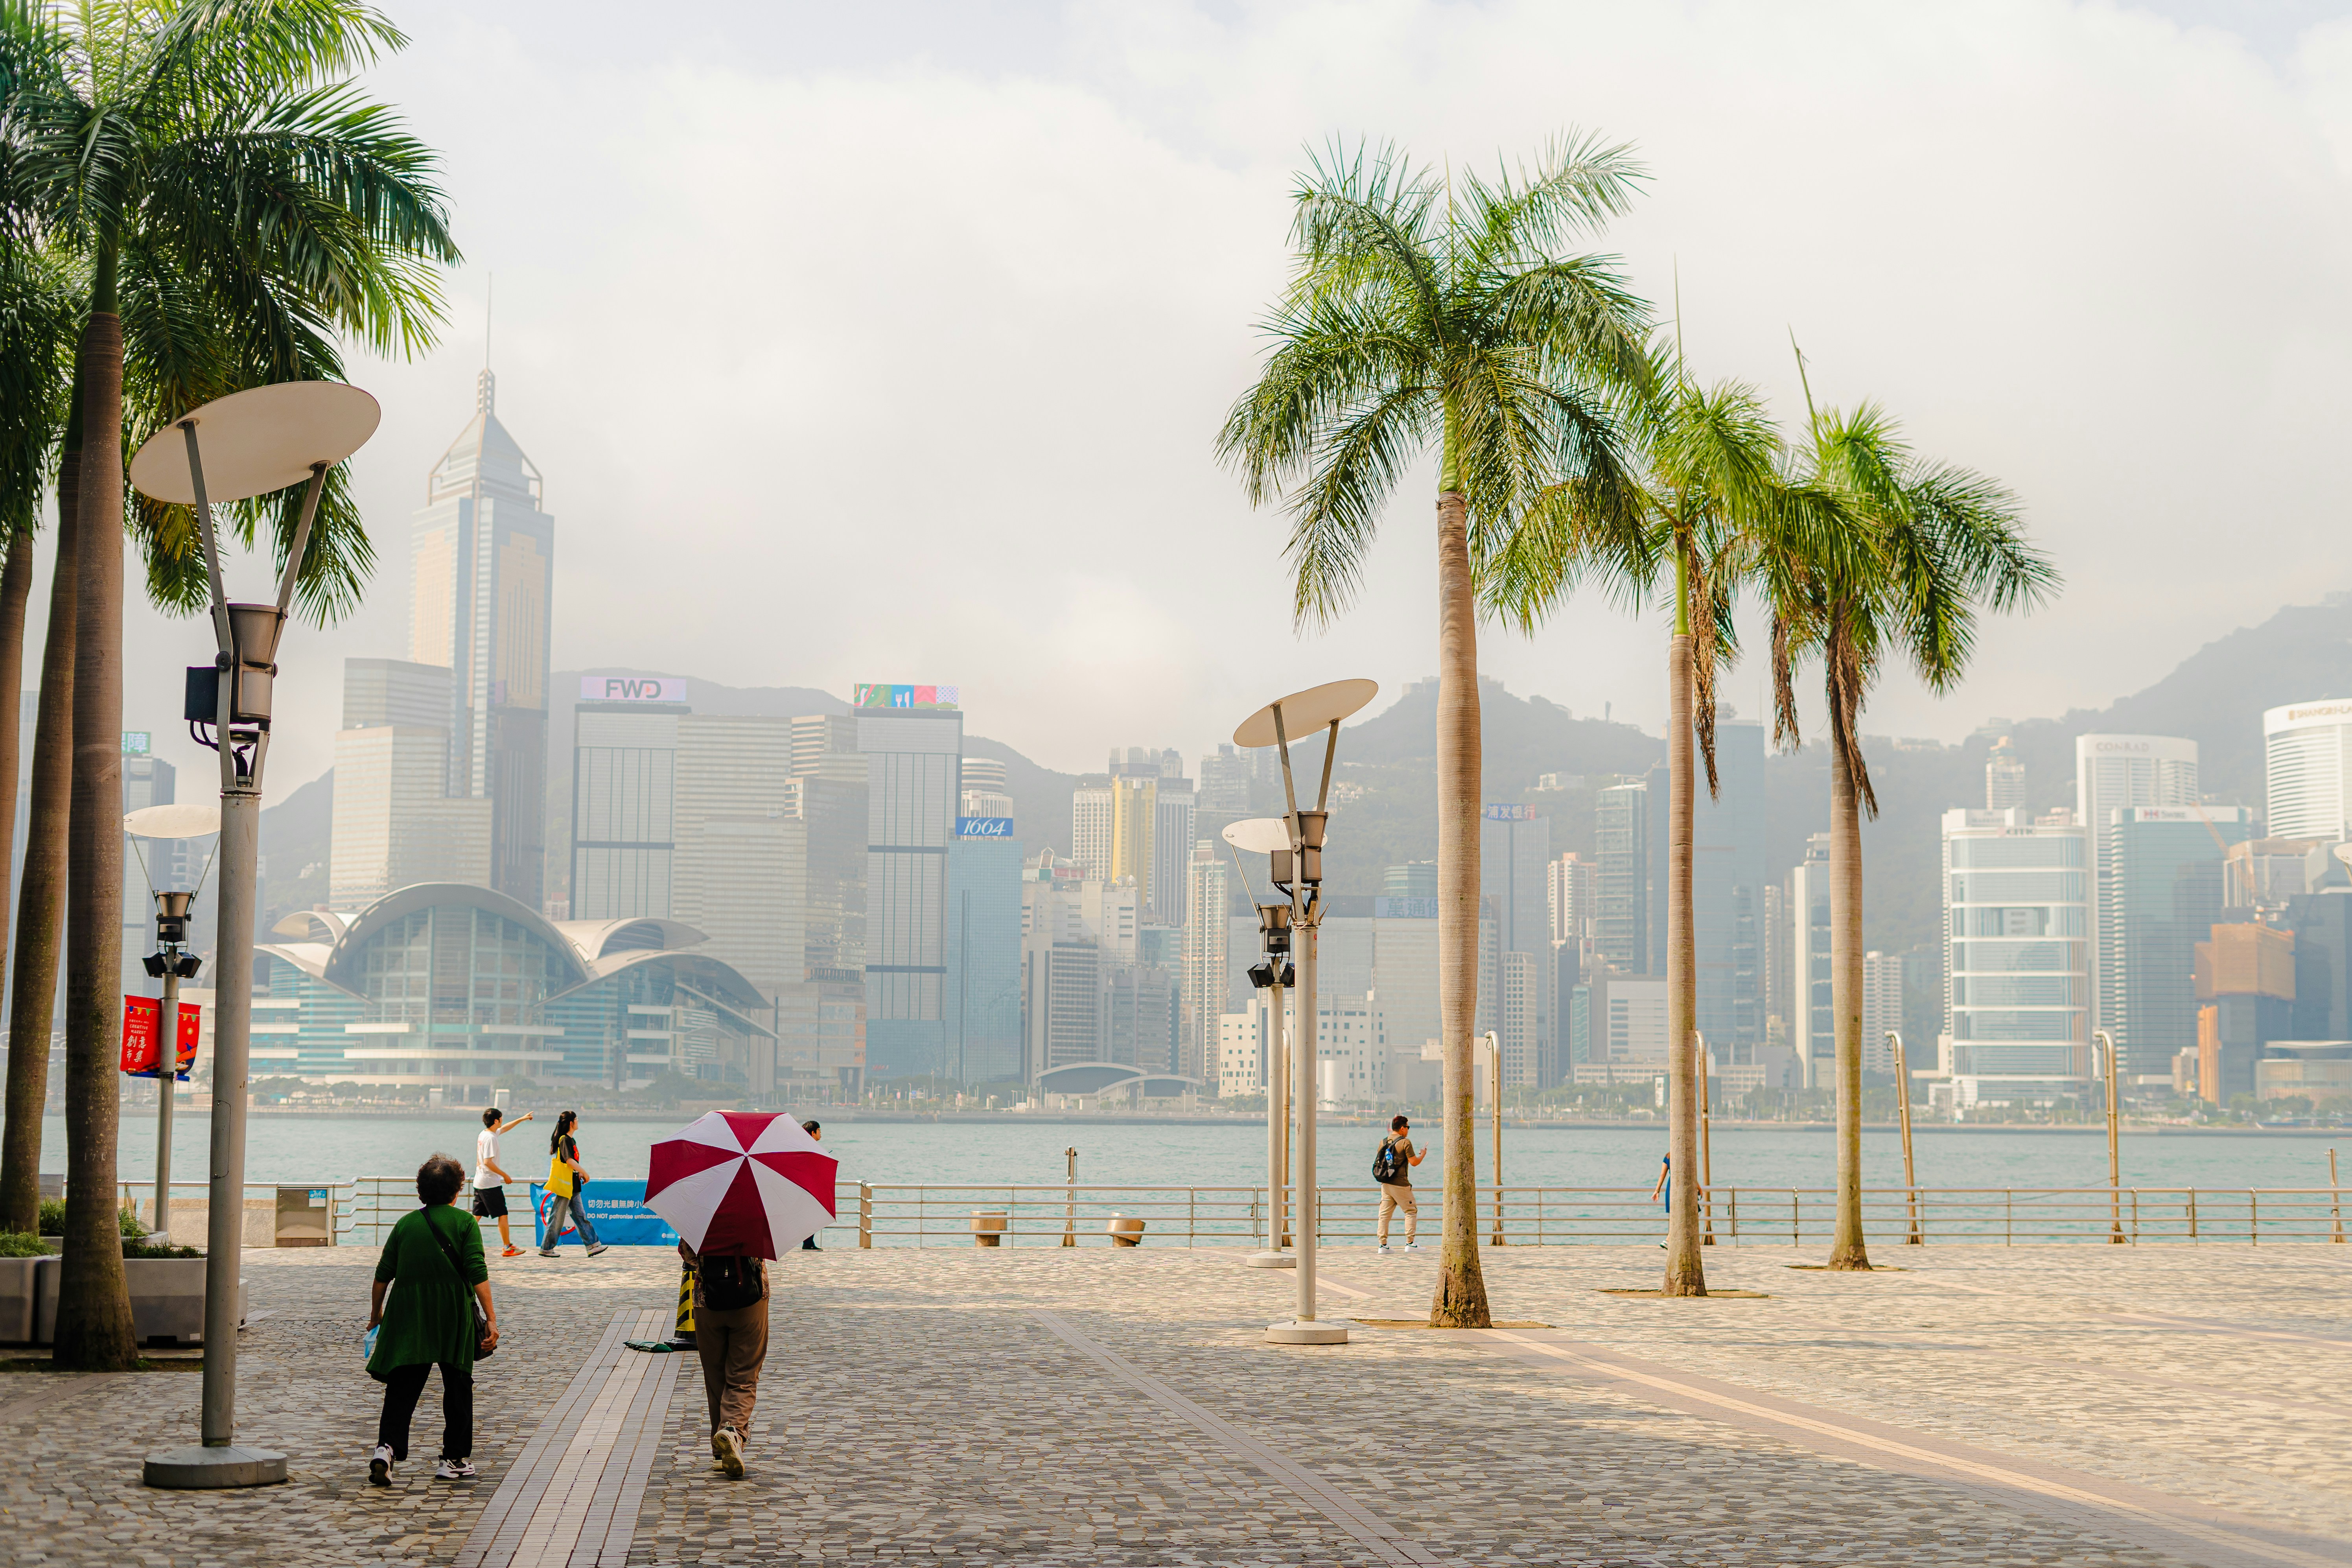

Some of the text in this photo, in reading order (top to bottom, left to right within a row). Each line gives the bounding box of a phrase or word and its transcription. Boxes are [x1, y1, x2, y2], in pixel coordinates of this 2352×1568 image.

[606, 679, 661, 698] FWD
[2096, 741, 2149, 752] CONRAD
[1488, 805, 1535, 818] 浦发银行
[964, 818, 1006, 835] 1664
[126, 1035, 146, 1048] 創意
[127, 1049, 143, 1062] 市集
